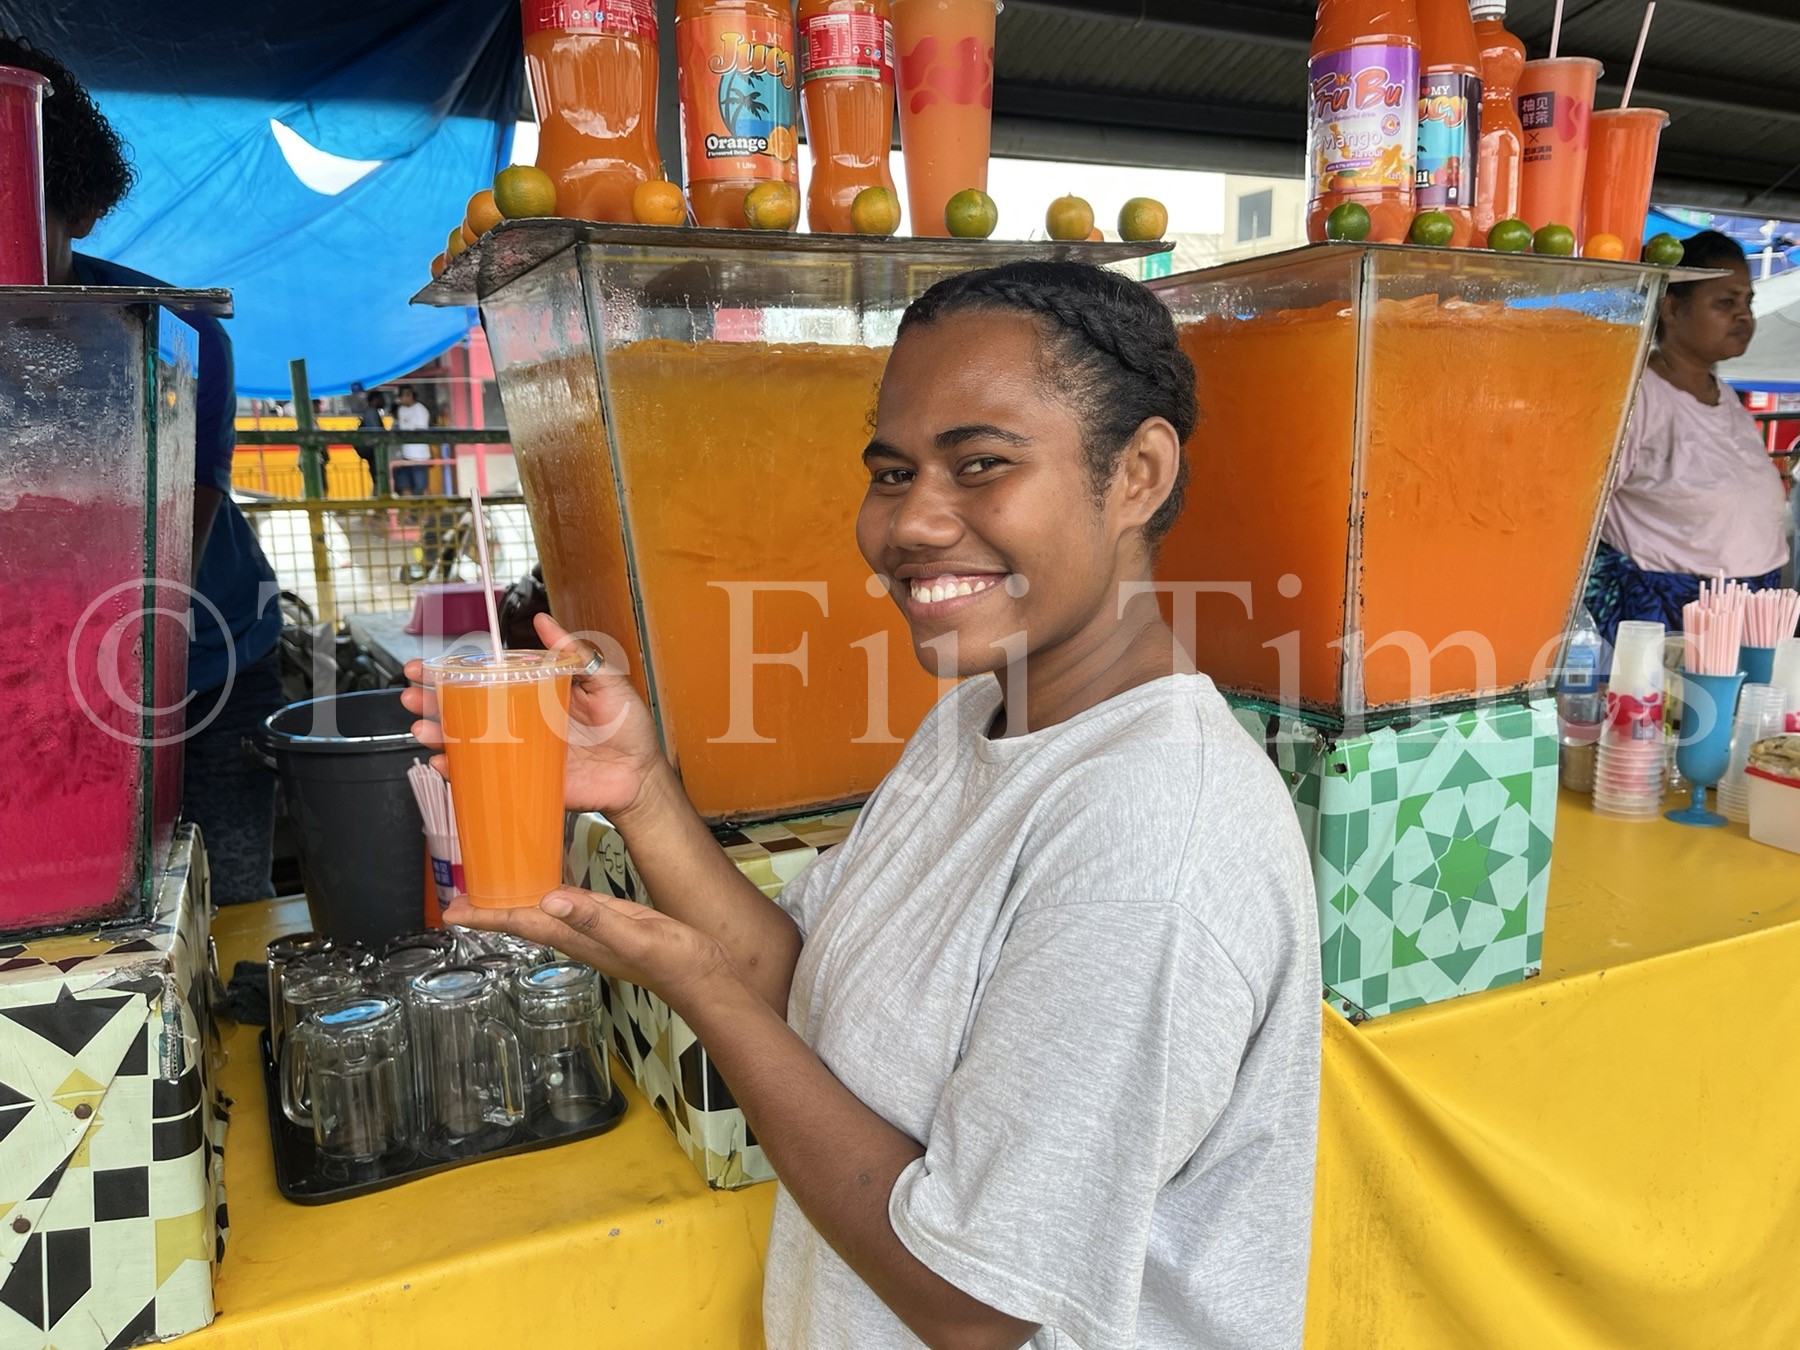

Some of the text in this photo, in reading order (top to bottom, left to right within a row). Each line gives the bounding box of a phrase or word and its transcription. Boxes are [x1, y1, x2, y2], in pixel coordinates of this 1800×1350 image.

[750, 29, 784, 45] I MY
[708, 32, 795, 89] Jucy
[1353, 66, 1405, 111] Bu
[1430, 85, 1450, 96] MY
[706, 135, 767, 152] Orange
[1322, 131, 1383, 151] Mango
[1349, 149, 1385, 159] Flavour
